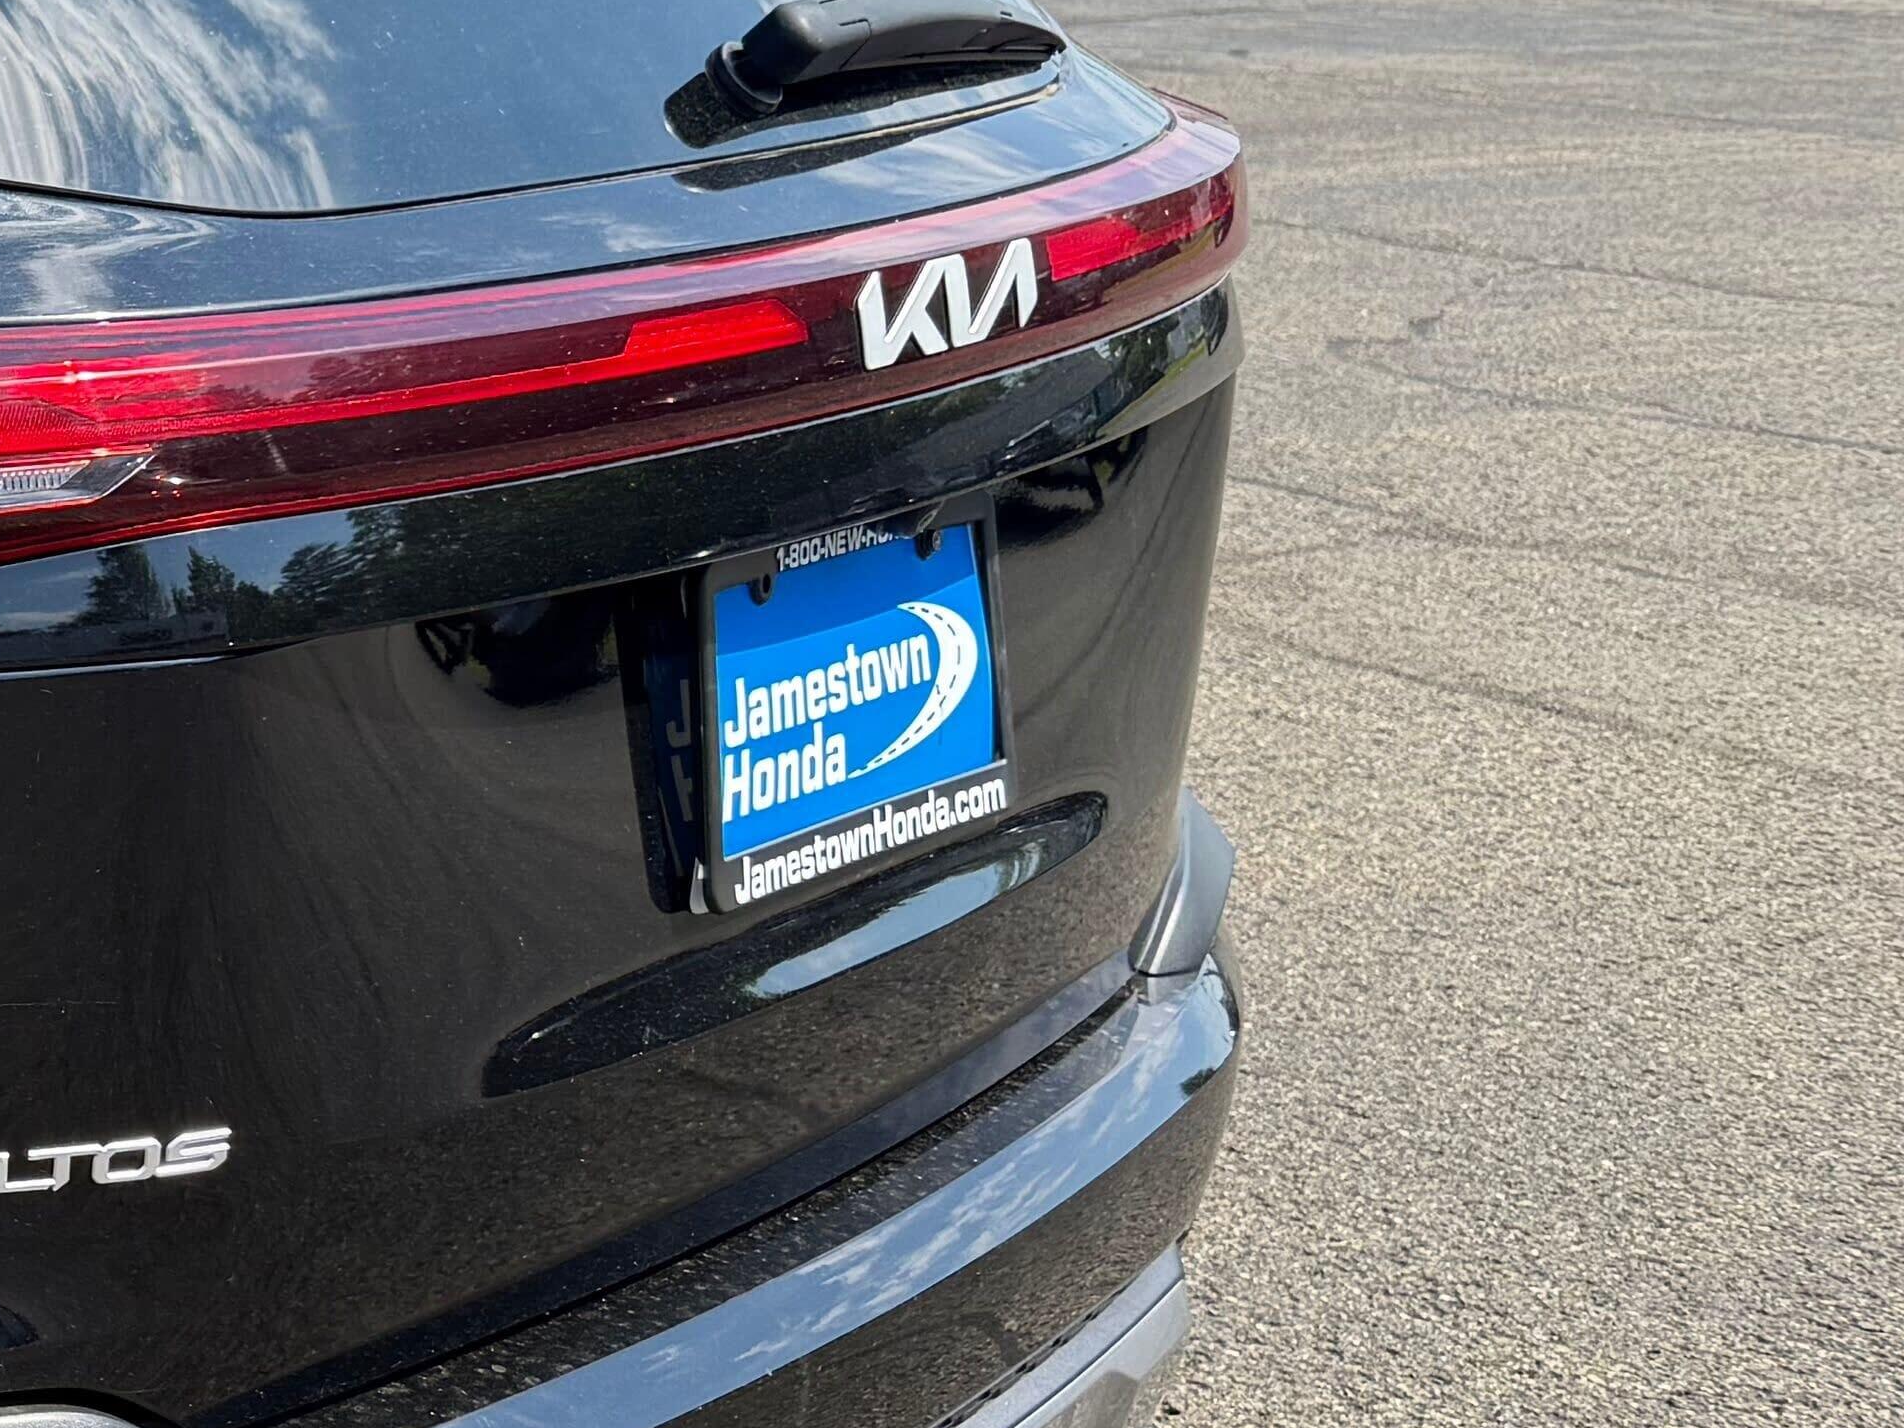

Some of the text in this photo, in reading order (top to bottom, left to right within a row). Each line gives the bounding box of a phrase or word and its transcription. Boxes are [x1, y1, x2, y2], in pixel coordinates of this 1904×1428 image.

[856, 237, 1039, 371] KIA
[724, 634, 932, 748] Jamestown
[722, 722, 847, 823] Honda
[734, 777, 1007, 905] JamestownHonda.com
